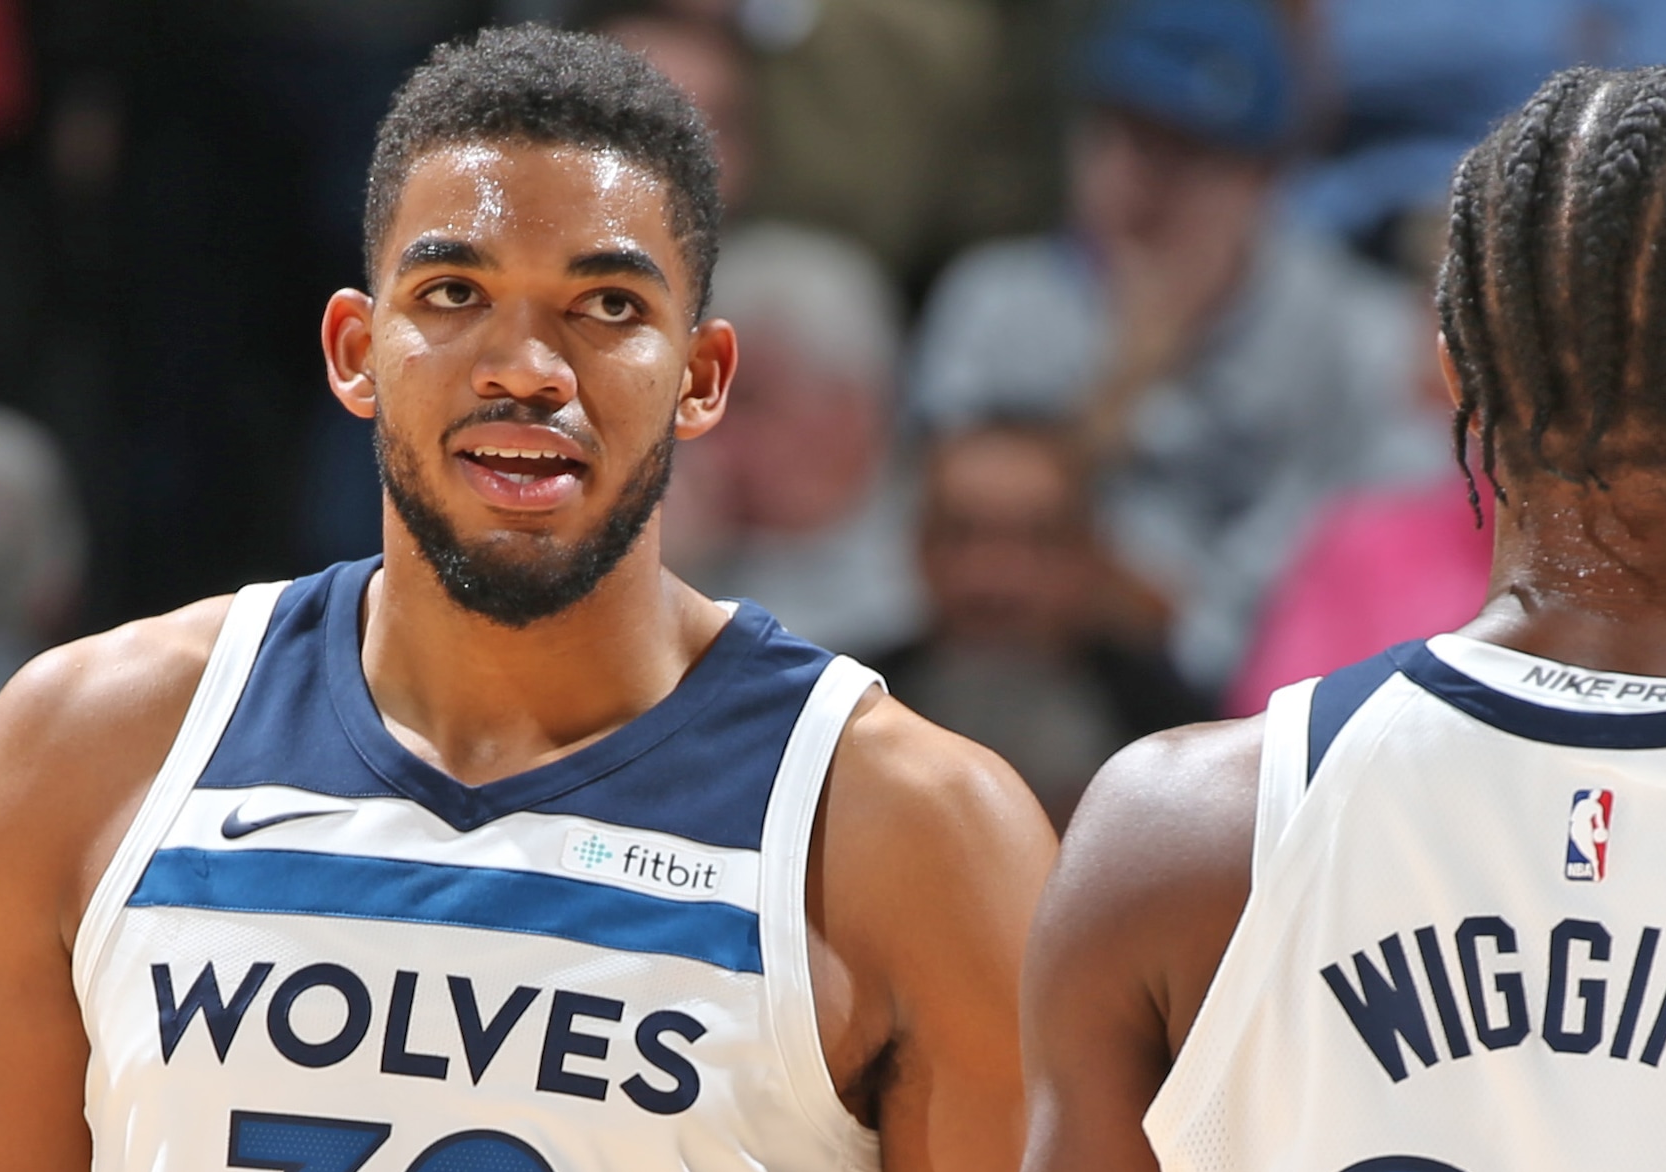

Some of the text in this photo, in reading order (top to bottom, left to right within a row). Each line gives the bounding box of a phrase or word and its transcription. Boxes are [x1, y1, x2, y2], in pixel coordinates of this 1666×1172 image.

[1522, 666, 1616, 698] NIKE
[623, 844, 718, 889] fitbit
[1567, 862, 1593, 878] NBA
[150, 961, 708, 1116] WOLVES
